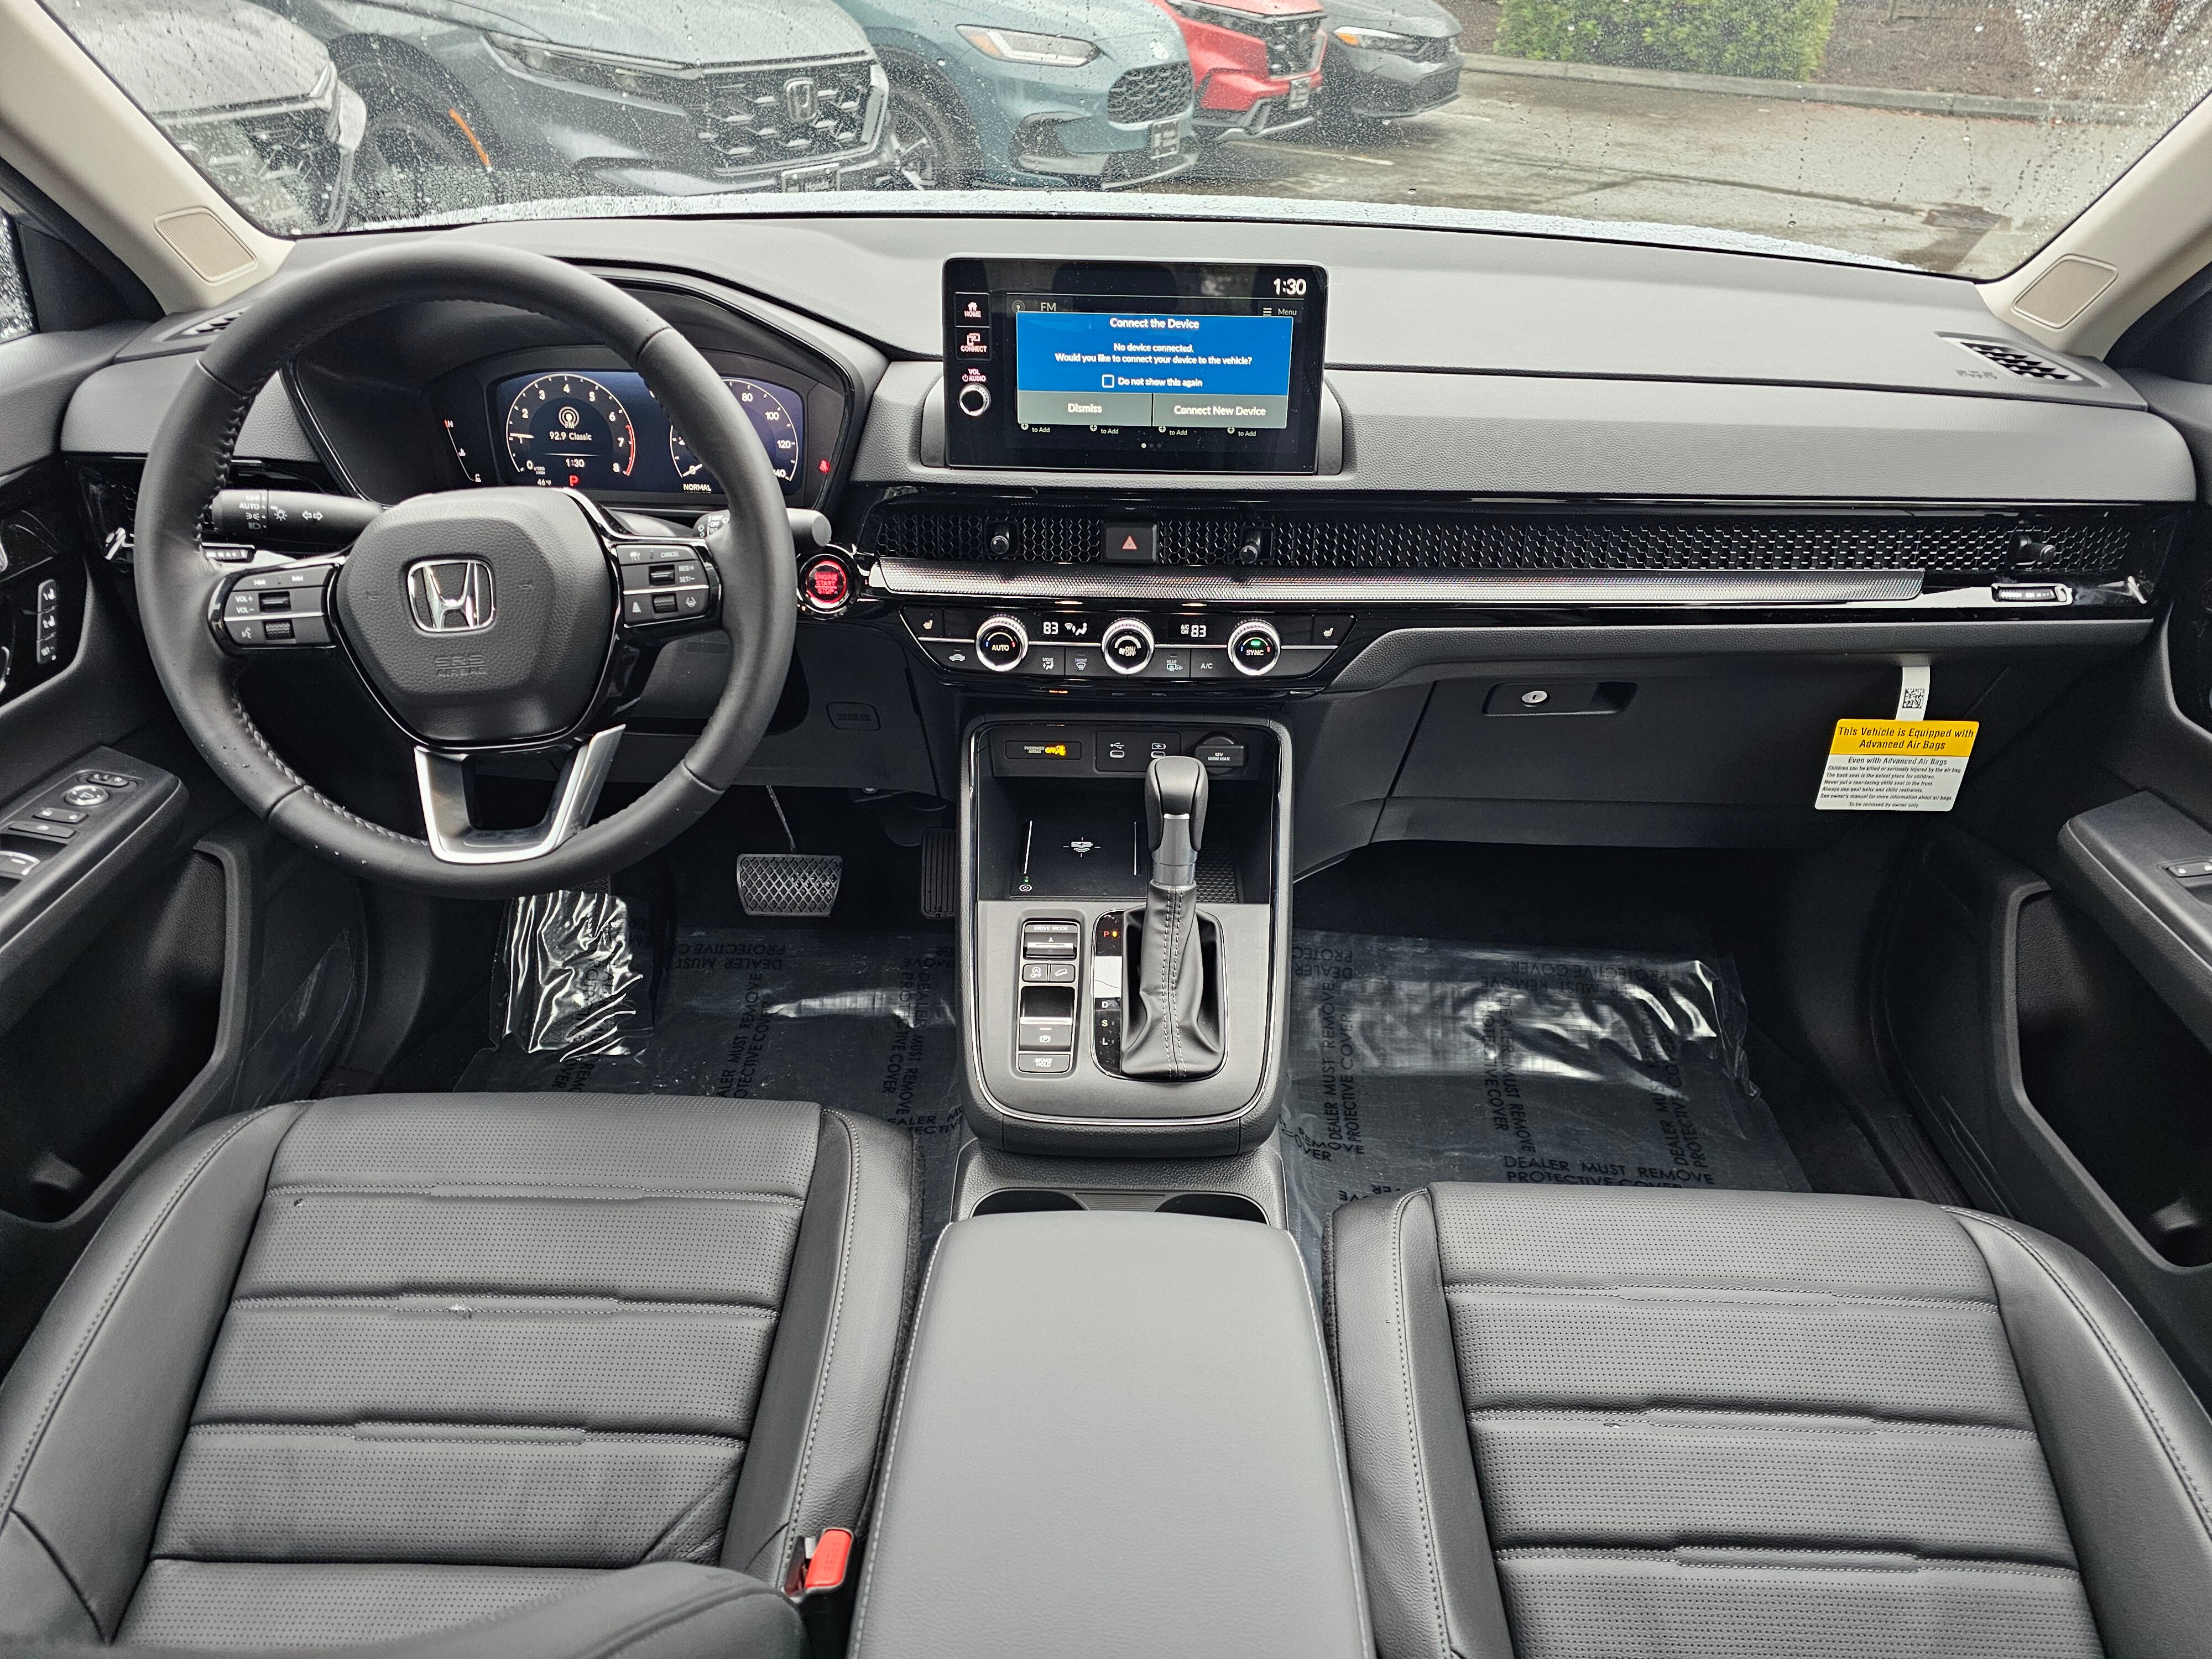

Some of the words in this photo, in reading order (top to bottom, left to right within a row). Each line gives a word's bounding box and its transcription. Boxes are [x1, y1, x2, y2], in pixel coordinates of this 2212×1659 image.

[1273, 278, 1307, 295] 1:30
[1041, 302, 1056, 311] FM
[1109, 317, 1149, 327] Connect
[1150, 318, 1166, 327] the
[1167, 319, 1199, 328] Device
[1114, 343, 1125, 351] No
[1126, 343, 1152, 352] device
[1152, 344, 1194, 352] connected.
[1055, 353, 1081, 362] Would
[1098, 354, 1111, 362] like
[1154, 356, 1172, 364] your
[1172, 356, 1197, 364] device
[1198, 356, 1207, 364] to
[1208, 356, 1221, 364] the
[1222, 356, 1253, 365] vehicle?
[563, 384, 570, 393] 4
[1145, 378, 1166, 386] show
[1166, 378, 1181, 386] this
[1182, 378, 1203, 388] again
[539, 390, 545, 400] 3
[589, 392, 595, 402] 5
[742, 393, 753, 402] 80
[522, 408, 529, 419] 2
[1067, 403, 1102, 413] Dismiss
[1173, 405, 1211, 415] Connect
[1213, 406, 1234, 415] New
[1235, 406, 1266, 416] Device
[609, 411, 616, 421] 6
[765, 411, 779, 420] 100
[549, 431, 566, 440] 92.9
[568, 432, 592, 441] Classic
[617, 437, 624, 447] 7
[776, 440, 791, 448] 120
[526, 460, 533, 470] 0
[566, 458, 585, 468] 1:30
[613, 463, 620, 473] 8
[569, 475, 579, 487] P
[1043, 622, 1058, 634] 83
[1191, 625, 1206, 637] 83
[1839, 727, 1858, 735] This
[1861, 727, 1895, 736] Vehicle
[1897, 728, 1906, 737] is
[1908, 728, 1952, 739] Equipped
[1954, 729, 1974, 738] with
[1859, 739, 1905, 748] Advanced
[1906, 740, 1921, 749] Air
[1923, 741, 1945, 751] Bags
[695, 943, 786, 956] PROTECTIVE
[675, 957, 714, 968] MUST
[724, 957, 782, 969] DEALER
[1295, 964, 1353, 979] DEALER
[914, 972, 931, 1028] DEALER
[728, 1035, 749, 1063] MUST
[739, 973, 762, 1030] REMOVE
[1322, 982, 1337, 1048] REMOVE
[908, 1035, 925, 1062] MUST
[1340, 1014, 1354, 1071] COVER
[882, 1053, 903, 1094] COVER
[1322, 1058, 1337, 1095] MUST
[1501, 1064, 1521, 1100] MUST
[896, 1067, 918, 1115] REMOVE
[1341, 1074, 1361, 1142] PROTECTIVE
[1324, 1102, 1343, 1141] DEALER
[1508, 1103, 1536, 1154] REMOVE
[1663, 1119, 1689, 1166] DEALER
[1504, 1155, 1570, 1172] DEALER
[1581, 1162, 1626, 1176] MUST
[1637, 1166, 1716, 1185] REMOVE
